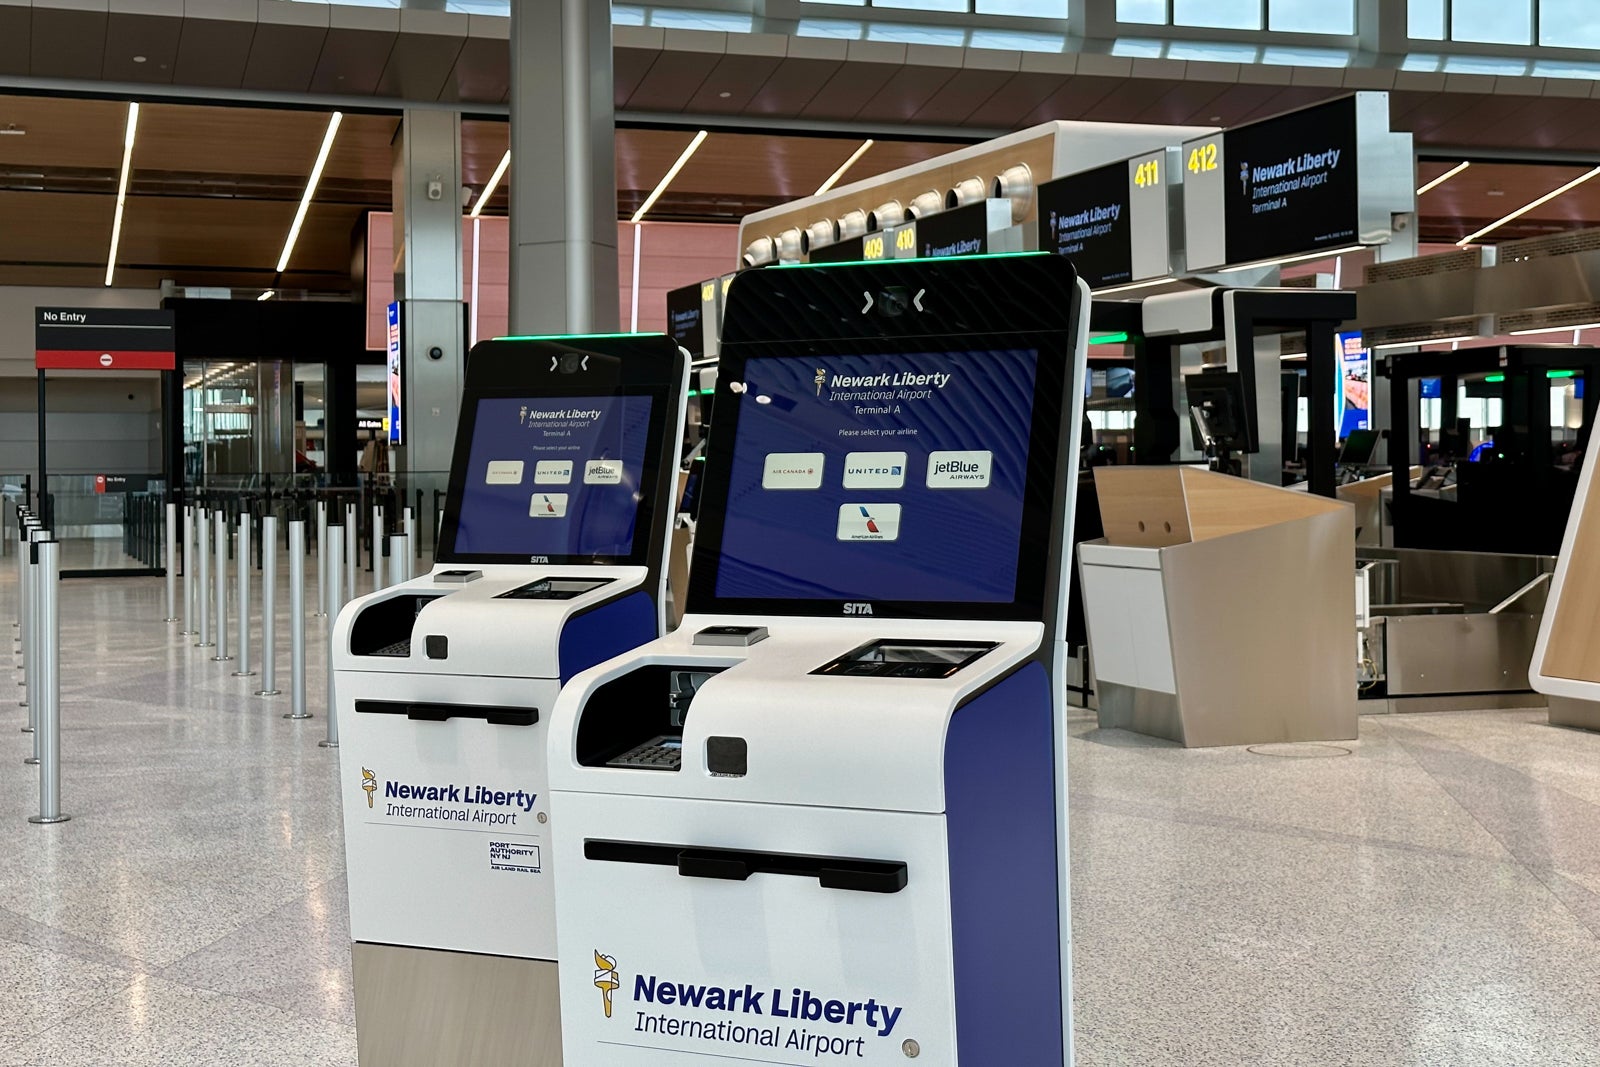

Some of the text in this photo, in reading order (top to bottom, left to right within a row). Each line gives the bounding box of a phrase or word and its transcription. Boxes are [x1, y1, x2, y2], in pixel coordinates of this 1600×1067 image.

[1187, 143, 1218, 174] 412
[1252, 148, 1341, 183] Newark Liberty
[1134, 159, 1159, 188] 411
[1252, 171, 1328, 199] International Airport
[1251, 197, 1288, 214] Terminal A
[1058, 203, 1121, 230] Newark Liberty
[896, 228, 915, 250] 410
[1058, 222, 1112, 243] International Airport
[864, 238, 884, 259] 409
[932, 238, 981, 257] Newark Liberty
[43, 311, 87, 323] No Entry
[829, 371, 951, 388] Newark Liberty
[829, 388, 932, 401] International Airport
[529, 409, 602, 420] Newark Liberty
[854, 405, 901, 415] Terminal A
[568, 420, 591, 429] Airport
[838, 428, 860, 436] Please
[860, 428, 880, 436] select
[880, 429, 897, 438] your
[588, 466, 615, 476] jetBlue
[933, 461, 979, 475] jetBlue
[530, 555, 549, 563] SITA
[842, 602, 873, 615] SITA
[385, 780, 538, 812] Newark Liberty
[386, 803, 518, 826] International Airport
[490, 841, 511, 849] PORT
[490, 847, 534, 856] AUTHORITY
[633, 974, 903, 1037] Newark Liberty
[634, 1011, 866, 1057] International Airport
